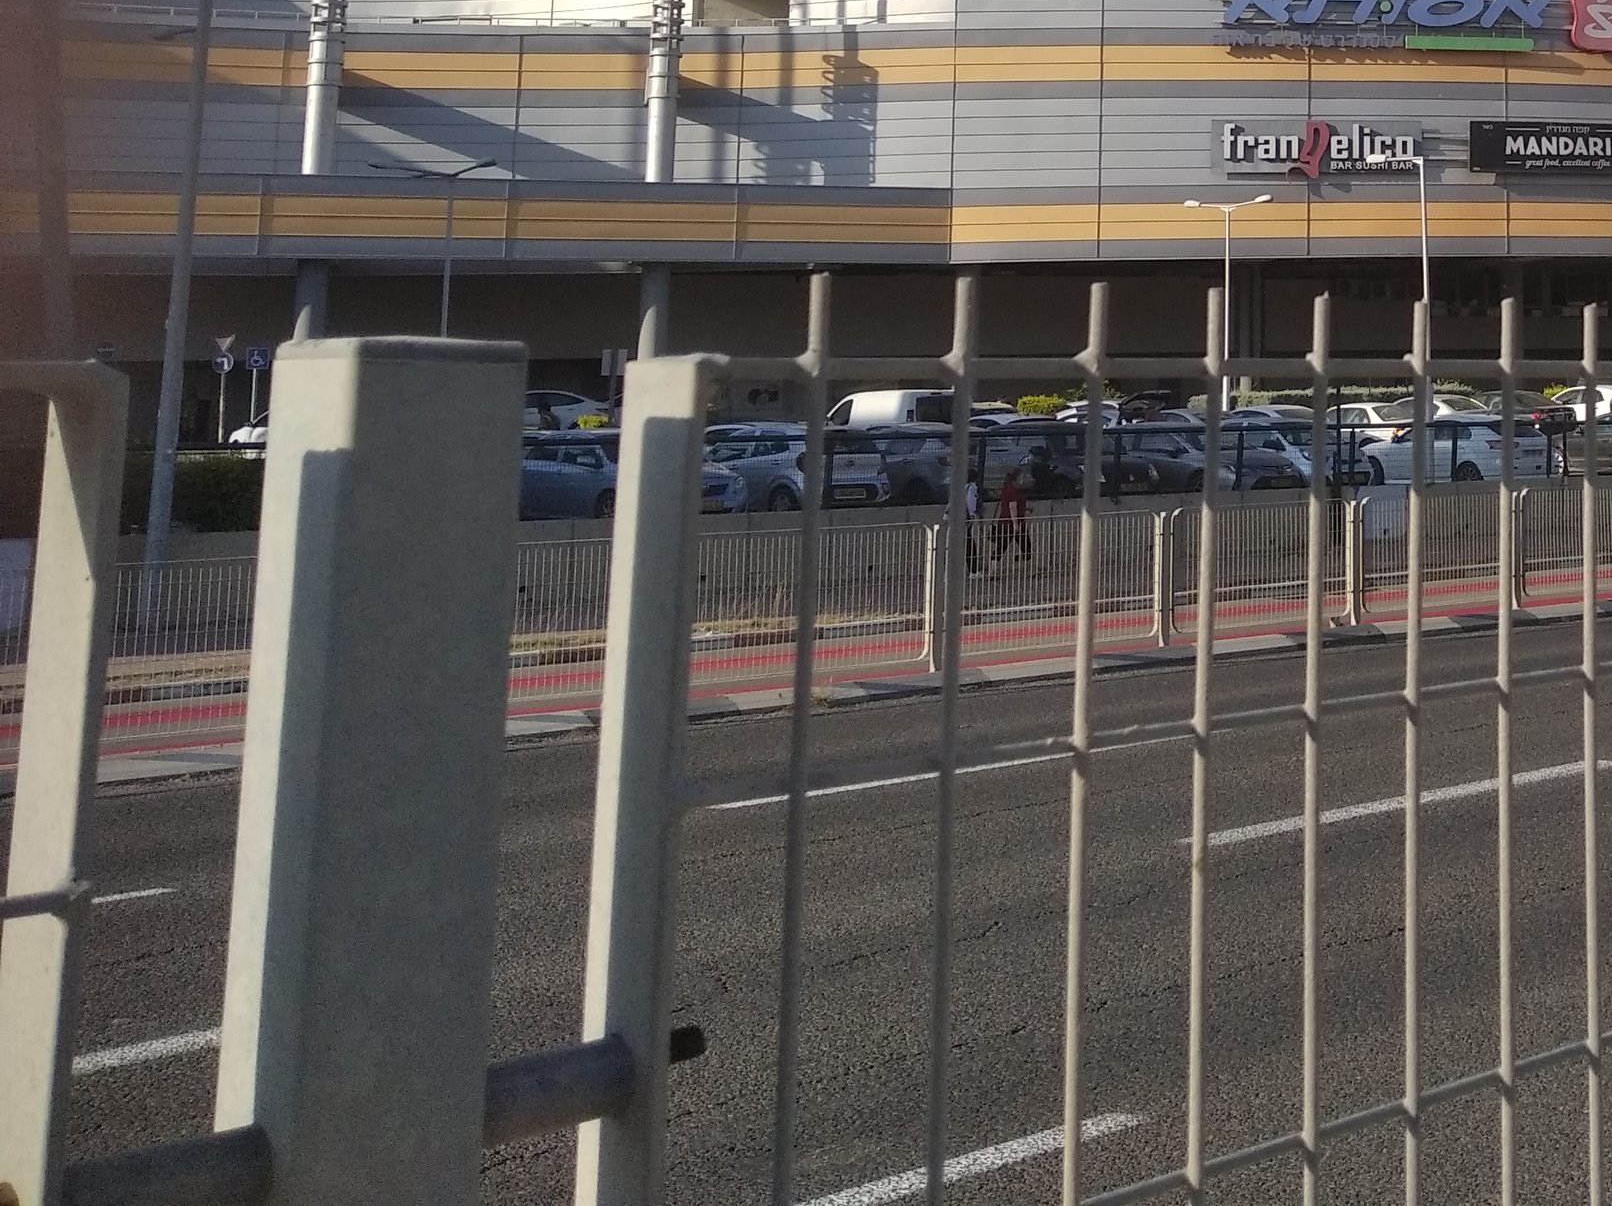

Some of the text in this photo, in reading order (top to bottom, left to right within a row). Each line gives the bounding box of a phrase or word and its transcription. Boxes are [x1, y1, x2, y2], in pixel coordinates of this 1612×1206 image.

[1545, 125, 1591, 135] קפה מנדרין
[1330, 161, 1414, 170] BAR SUSHI BAR
